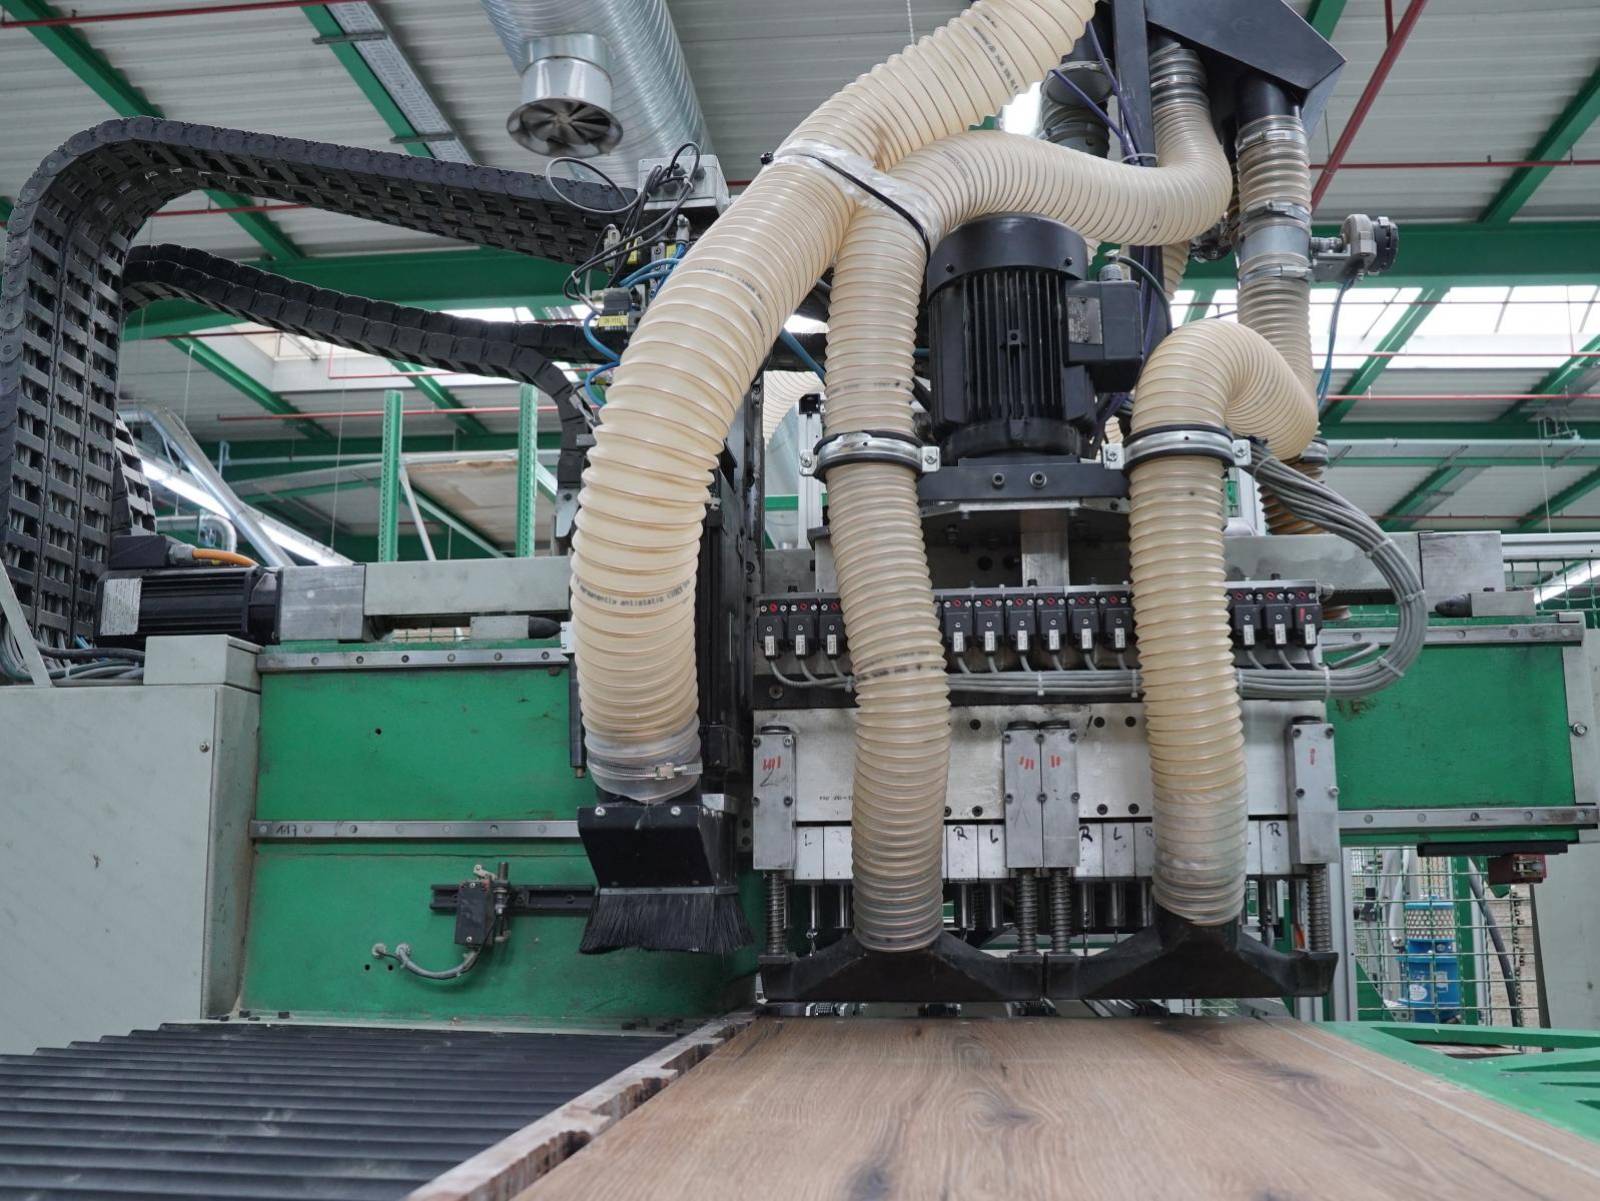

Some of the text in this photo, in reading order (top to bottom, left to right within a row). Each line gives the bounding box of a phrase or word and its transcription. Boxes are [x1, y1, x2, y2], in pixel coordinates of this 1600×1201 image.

[953, 826, 968, 841] R
[990, 829, 999, 843] L
[1079, 825, 1093, 842] R
[1114, 827, 1122, 841] L
[1266, 821, 1282, 837] R
